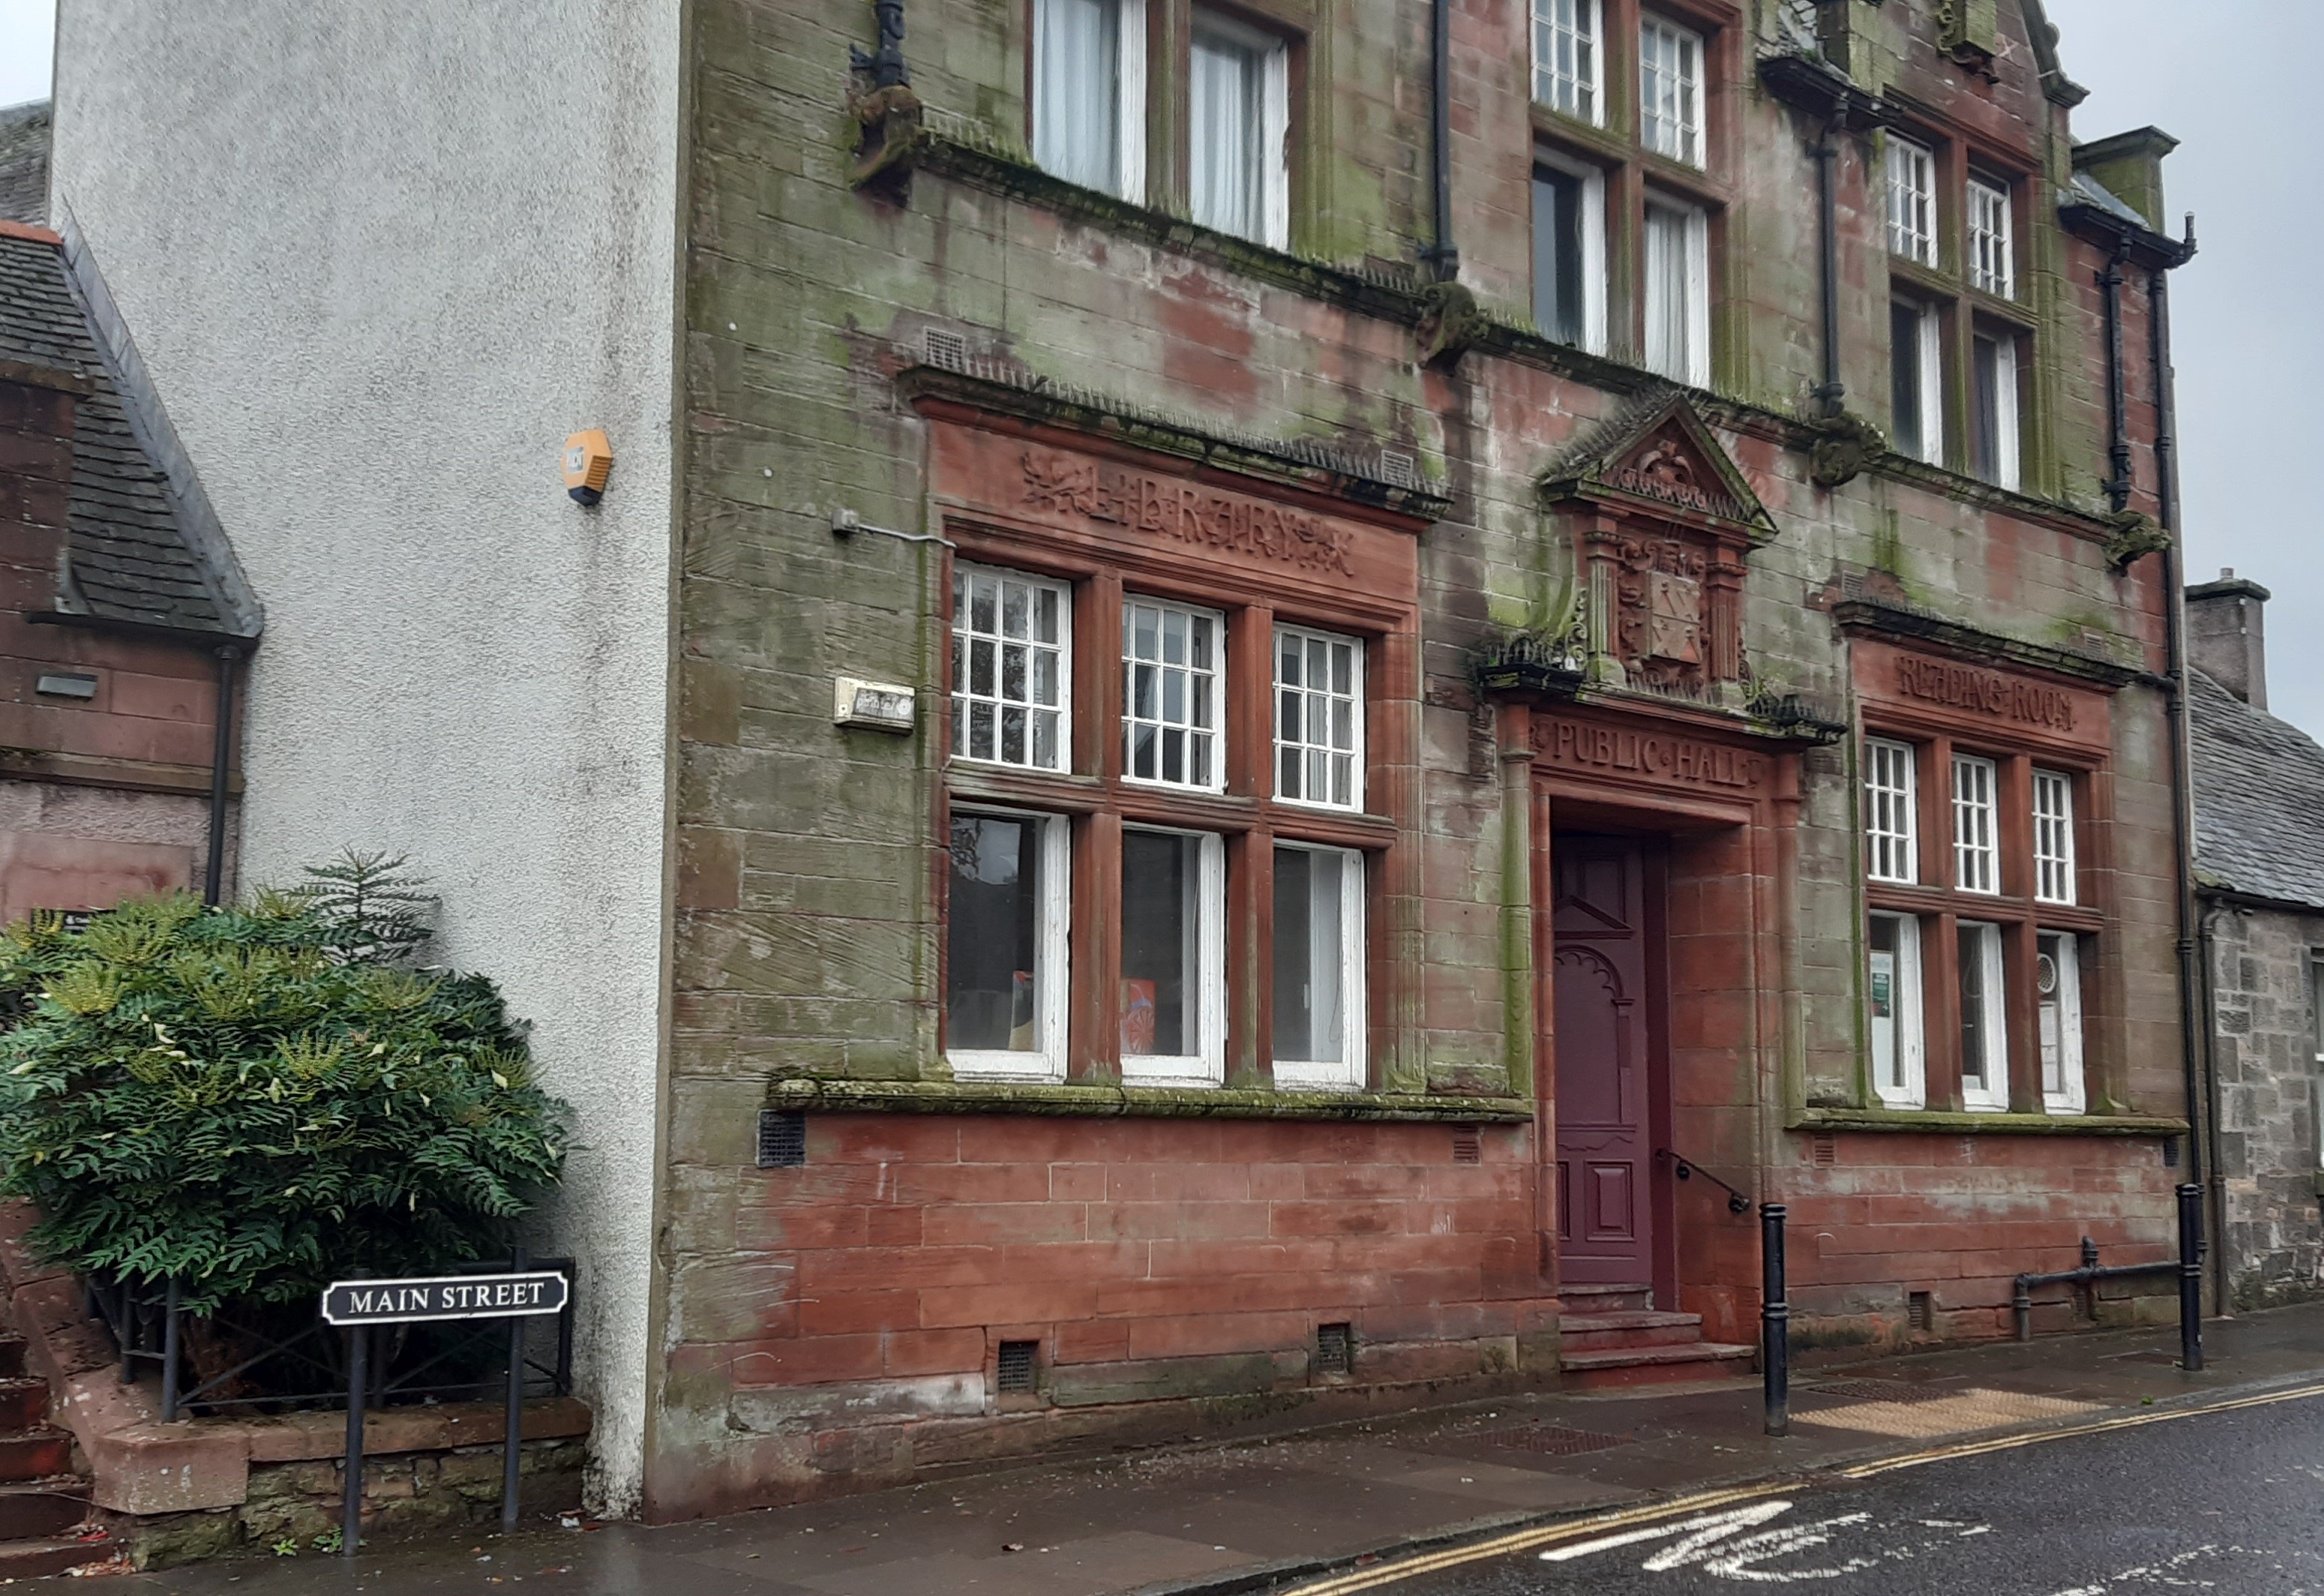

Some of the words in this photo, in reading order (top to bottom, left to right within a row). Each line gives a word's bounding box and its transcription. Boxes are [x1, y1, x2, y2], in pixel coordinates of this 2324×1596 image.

[1088, 464, 1297, 561] LIBRARY
[1894, 656, 2008, 715] READING
[2012, 679, 2076, 731] ROOM
[1552, 722, 1656, 773] PUBLIC
[1672, 740, 1749, 788] HALL
[349, 1288, 430, 1313] MAIN
[441, 1282, 545, 1309] STREET
